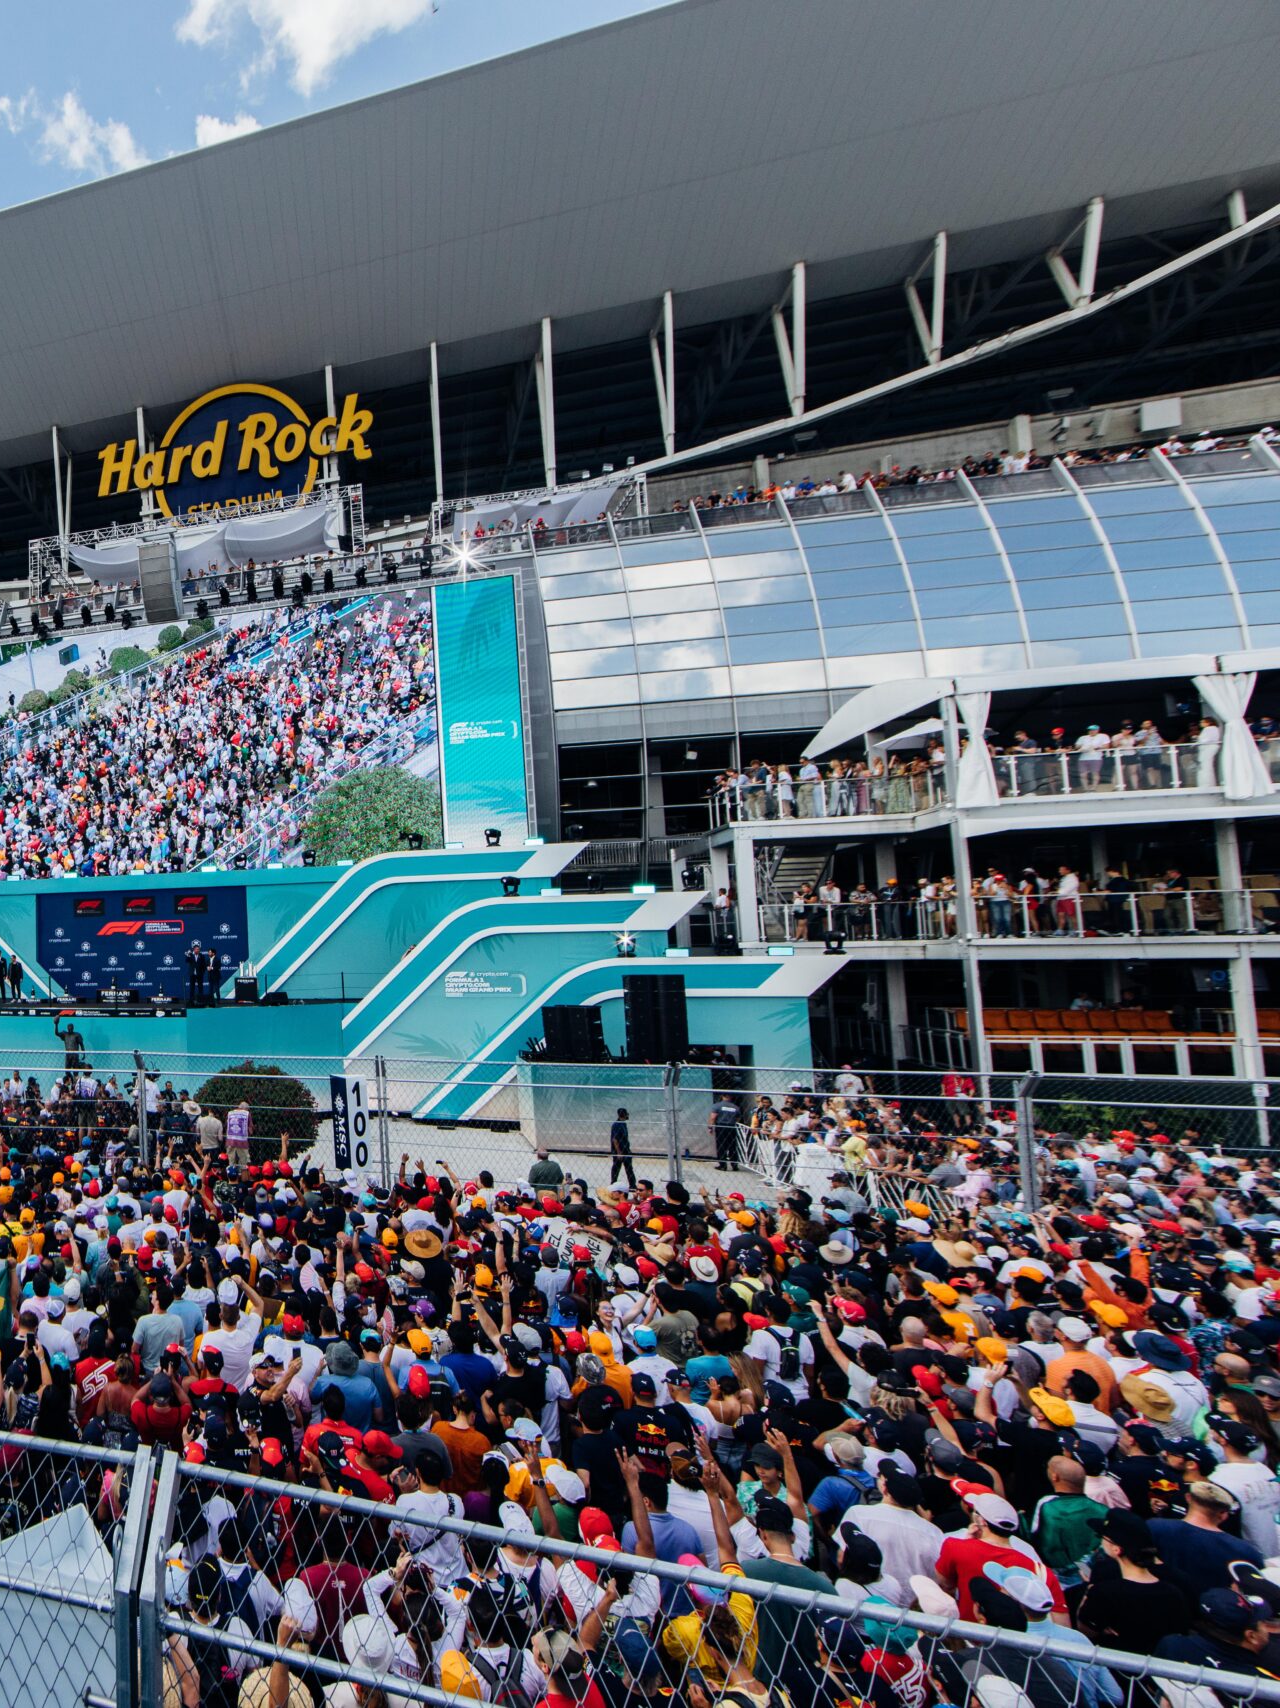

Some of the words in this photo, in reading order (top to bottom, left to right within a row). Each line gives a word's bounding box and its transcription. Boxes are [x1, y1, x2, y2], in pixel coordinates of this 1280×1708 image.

[98, 419, 228, 497] Hard
[237, 393, 373, 478] Rock
[338, 1115, 347, 1157] MSC
[352, 1082, 368, 1167] 100
[82, 1360, 115, 1404] 55
